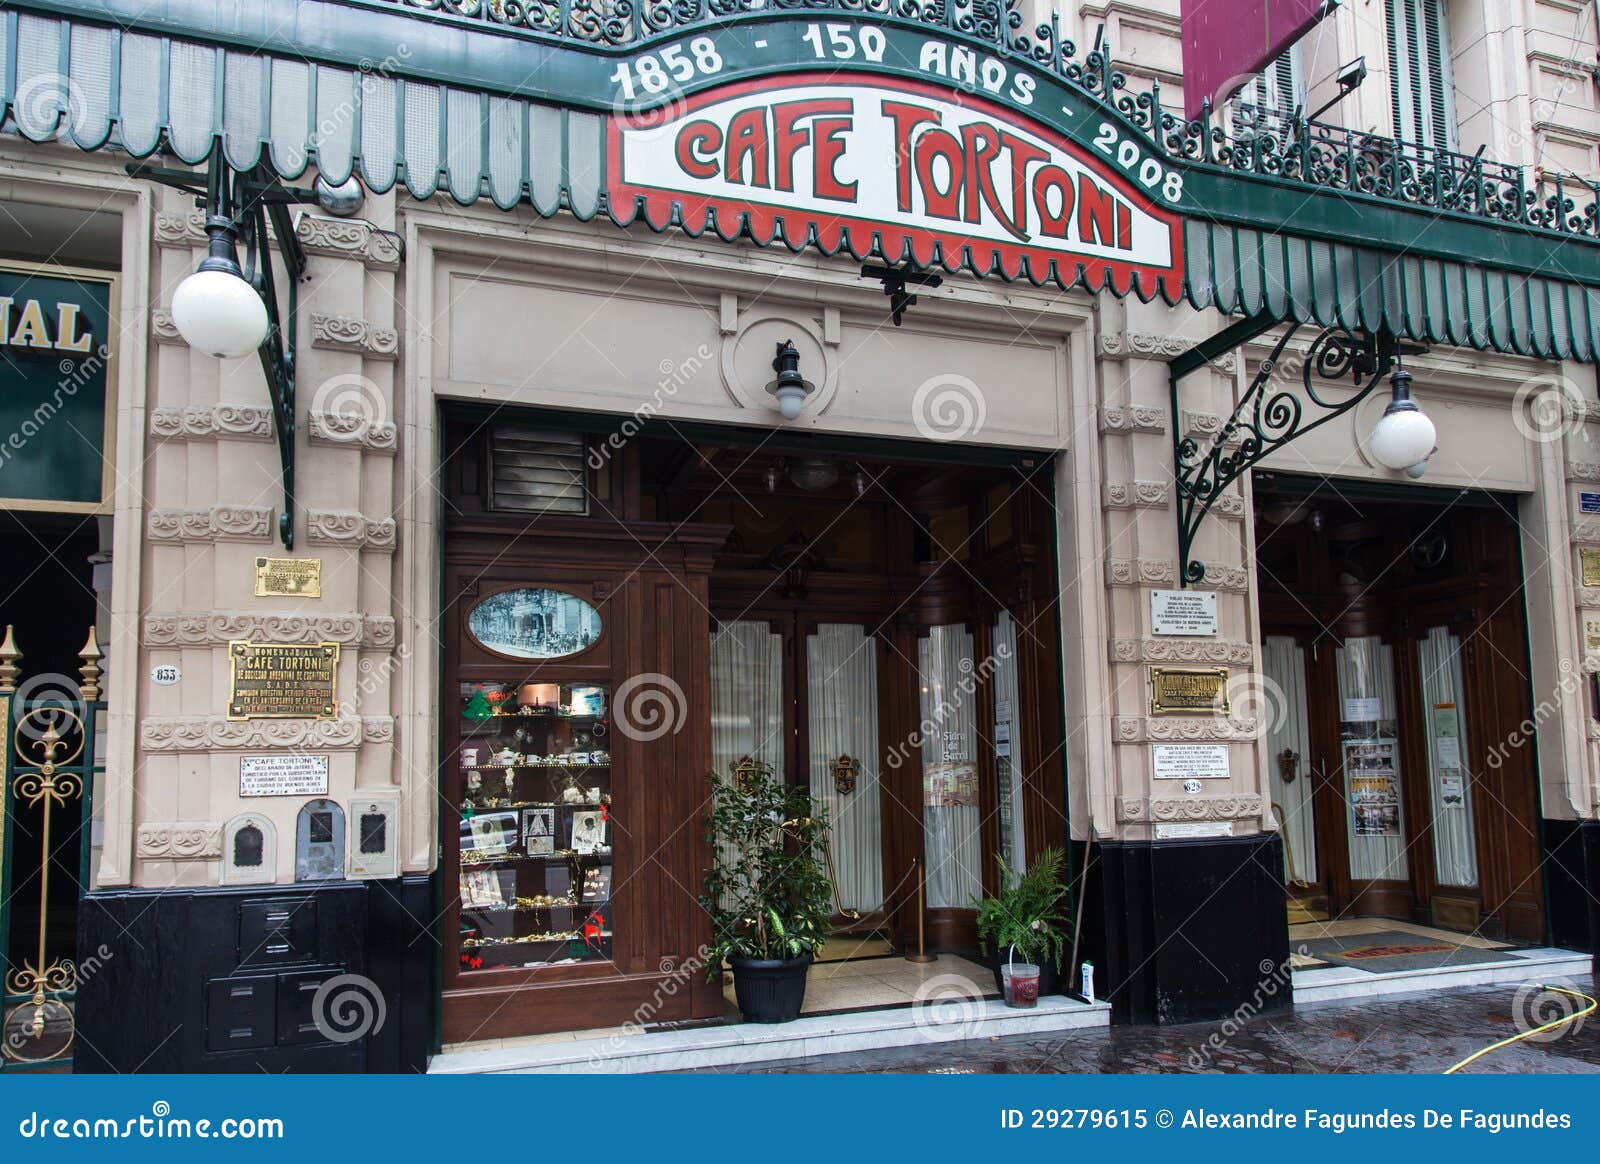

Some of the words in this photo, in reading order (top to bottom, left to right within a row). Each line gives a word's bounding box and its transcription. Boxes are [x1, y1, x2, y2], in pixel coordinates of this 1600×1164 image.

[610, 36, 724, 100] 1858
[802, 24, 886, 62] 150
[919, 40, 1036, 105] AÑOS
[1092, 122, 1184, 204] 2008
[675, 98, 858, 203] CAFE
[881, 99, 1134, 251] TORTONI
[157, 669, 175, 680] 833
[247, 656, 273, 669] CAFE
[280, 657, 322, 669] TORTONI
